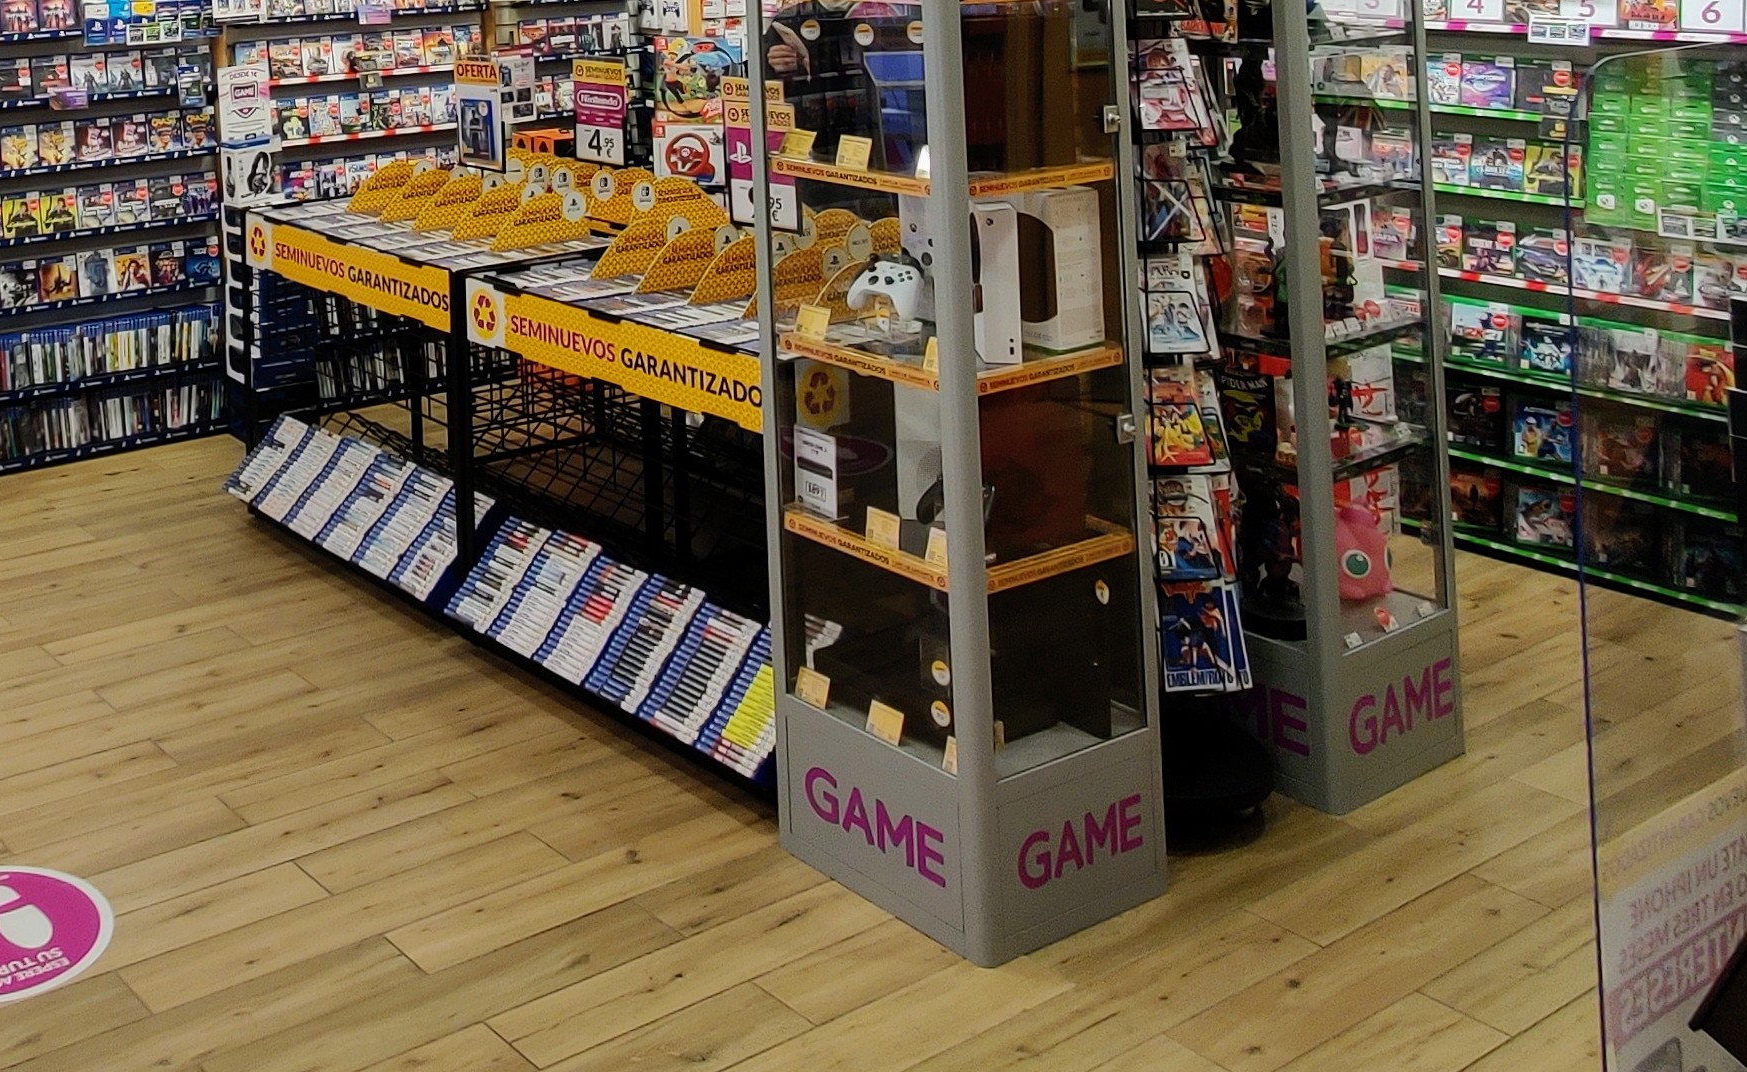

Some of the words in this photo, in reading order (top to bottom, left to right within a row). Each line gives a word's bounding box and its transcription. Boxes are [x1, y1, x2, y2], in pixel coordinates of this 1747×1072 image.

[1701, 1, 1722, 23] 6
[457, 64, 498, 79] OFERTA
[580, 94, 619, 107] Nintendo
[275, 241, 346, 279] SEMINUEVOS
[347, 265, 450, 313] GARANTIZADOS
[511, 315, 615, 363] SEMINUEVOS
[620, 346, 762, 409] GARANTIZADO
[1348, 658, 1453, 756] GAME
[803, 767, 946, 888] GAME
[1018, 794, 1145, 889] GAME
[17, 956, 71, 981] ESPERE
[38, 946, 64, 964] SU
